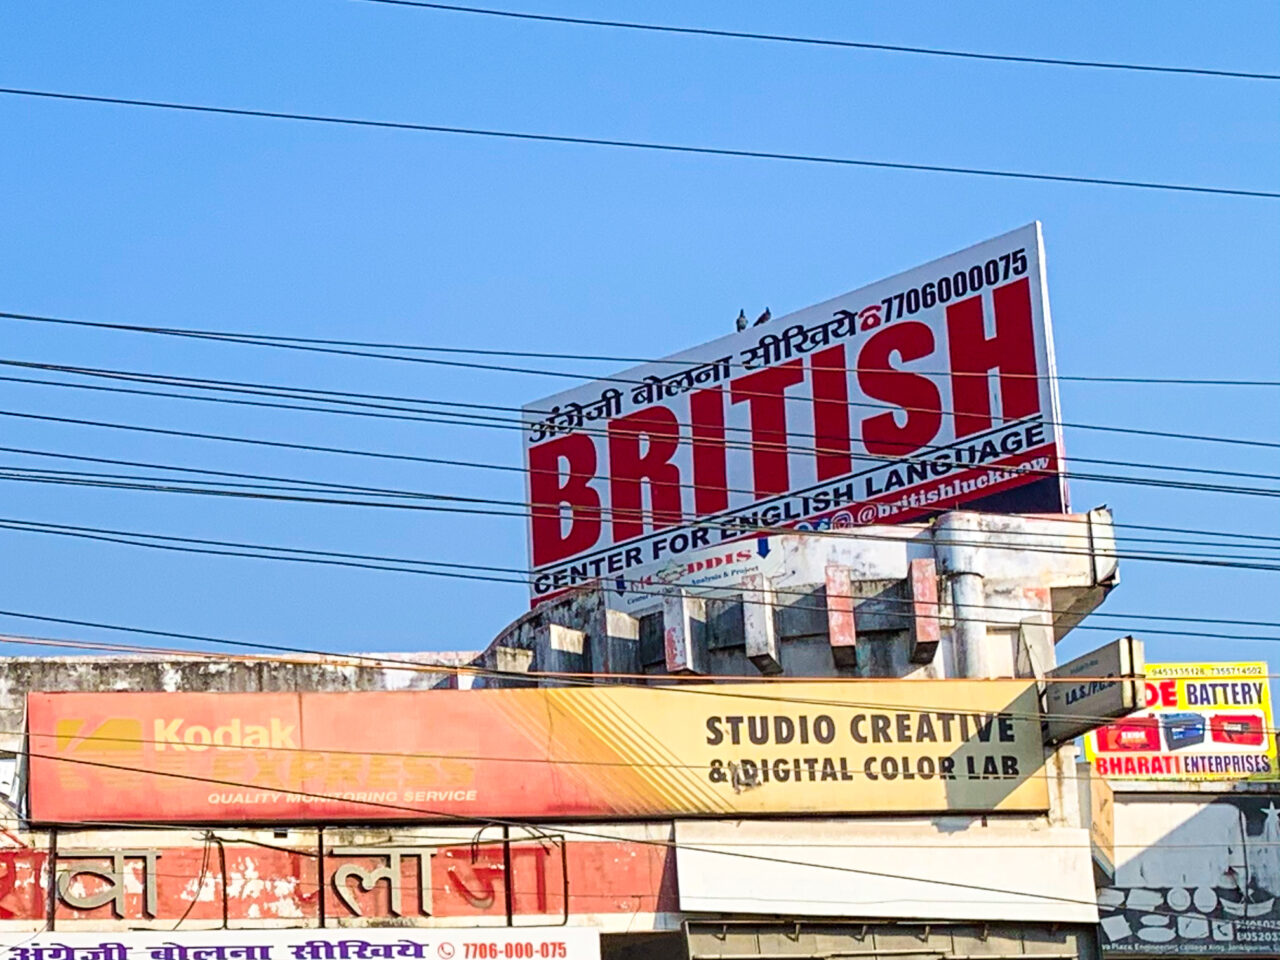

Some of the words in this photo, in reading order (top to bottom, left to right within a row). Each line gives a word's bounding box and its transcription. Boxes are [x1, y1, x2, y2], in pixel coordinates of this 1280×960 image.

[632, 356, 733, 407] बोलना
[882, 248, 1028, 323] 7706000075
[529, 277, 1040, 567] BRITISH
[534, 546, 642, 595] CENTER
[653, 527, 711, 559] FOR
[1186, 683, 1263, 705] BATTERY
[154, 718, 300, 751] Kodak
[706, 714, 835, 745] STUDIO
[850, 713, 1016, 743] CREATIVE
[213, 752, 474, 788] EXPRESS
[864, 756, 955, 780] COLOR
[967, 755, 1019, 780] LAB
[1096, 755, 1180, 775] BHARATI
[1184, 754, 1270, 773] ENTERPRISES
[208, 793, 282, 804] QUALITY
[286, 791, 398, 804] MONITORING
[403, 790, 476, 802] SERVICE
[463, 942, 567, 959] 7706-000-075
